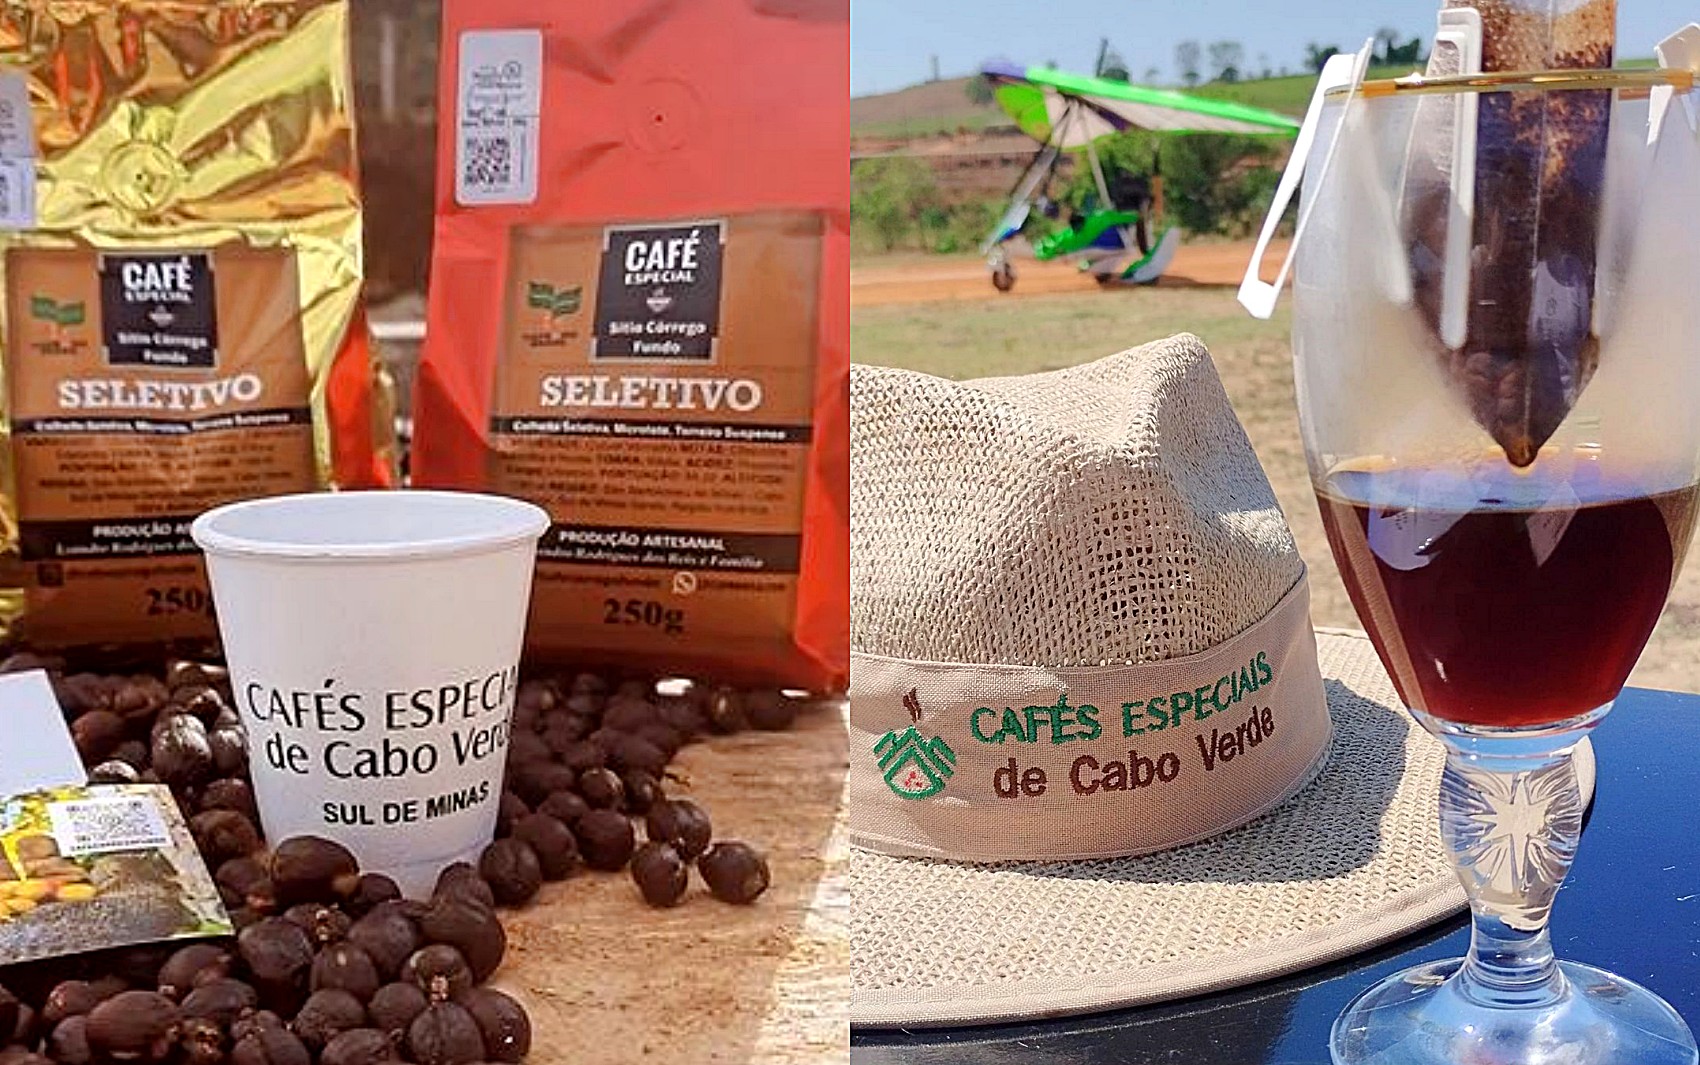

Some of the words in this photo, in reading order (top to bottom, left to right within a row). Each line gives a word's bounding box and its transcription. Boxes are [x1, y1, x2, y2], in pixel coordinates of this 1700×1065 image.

[625, 230, 699, 271] CAFÉ
[122, 256, 192, 290] CAFÉ
[625, 270, 695, 285] ESPECIAL
[633, 340, 681, 354] Fundo
[646, 321, 707, 337] Córrego
[57, 373, 262, 410] SELETIVO
[541, 375, 762, 412] SELETIVO
[92, 521, 172, 538] PRODUÇÃO
[558, 530, 640, 548] PRODUÇÃO
[643, 536, 726, 551] ARTESANAL
[603, 598, 684, 634] 250g
[247, 679, 366, 732] CAFÉS
[970, 694, 1101, 744] CAFÉS
[1121, 650, 1273, 738] ESPECIAIS
[266, 732, 309, 775] de
[324, 738, 438, 779] Cabo
[994, 758, 1047, 798] de
[1069, 750, 1181, 796] Cabo
[1196, 704, 1275, 772] Verde
[323, 802, 374, 825] SUL
[383, 800, 418, 825] DE
[426, 780, 489, 819] MINAS
